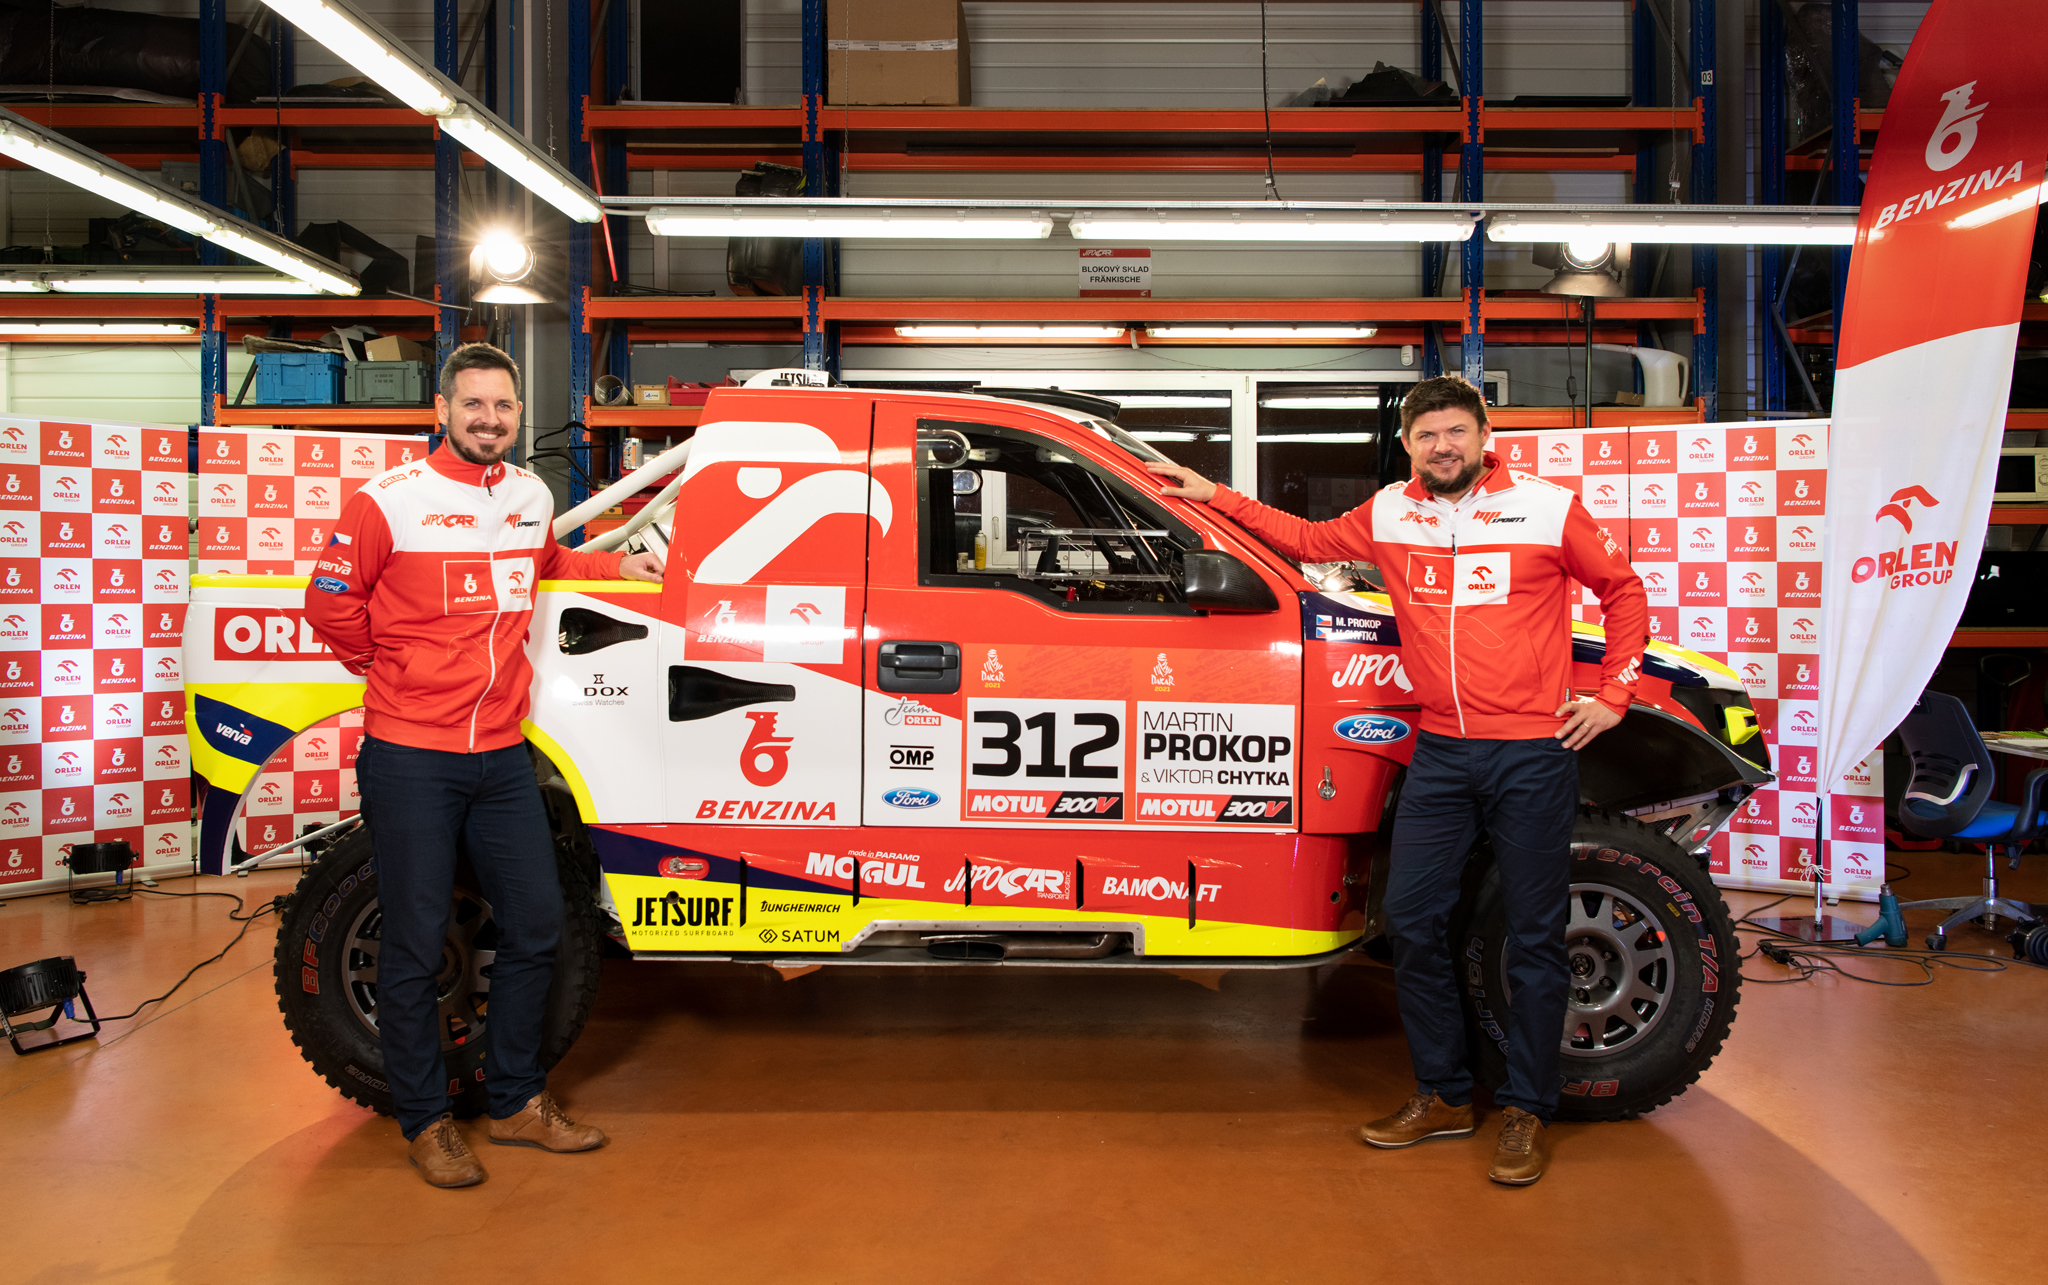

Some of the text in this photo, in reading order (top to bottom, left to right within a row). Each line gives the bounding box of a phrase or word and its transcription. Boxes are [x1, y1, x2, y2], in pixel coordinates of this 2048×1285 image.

[1703, 73, 1711, 82] 03
[1874, 160, 2022, 230] BENZINA
[380, 474, 406, 487] ORLEN
[318, 560, 352, 575] verva
[1851, 541, 1958, 583] ORLEN
[318, 579, 342, 591] Ford
[1891, 569, 1953, 589] GROUP
[454, 595, 492, 603] BENZINA
[1336, 617, 1381, 628] M. PROKOP
[223, 615, 333, 654] ORL
[584, 687, 629, 696] DOX
[906, 716, 939, 724] ORLEN
[1144, 711, 1232, 732] MARTIN
[216, 723, 253, 745] verva
[1348, 720, 1399, 738] Ford
[972, 710, 1119, 779] 312
[1143, 734, 1291, 763] PROKOP
[890, 750, 934, 765] OMP
[1141, 769, 1290, 786] & VIKTOR CHYTKA
[892, 790, 930, 805] Ford
[971, 795, 1119, 813] MOTUL 300V
[695, 800, 836, 820] BENZINA
[1140, 798, 1288, 818] MOTUL 300V
[50, 816, 87, 825] BENZINA
[876, 852, 920, 861] PARAMO
[805, 852, 925, 888] MOGUL
[632, 898, 734, 926] JETSURF
[760, 900, 840, 913] JUNGHEINRICH
[782, 930, 840, 942] SATUM
